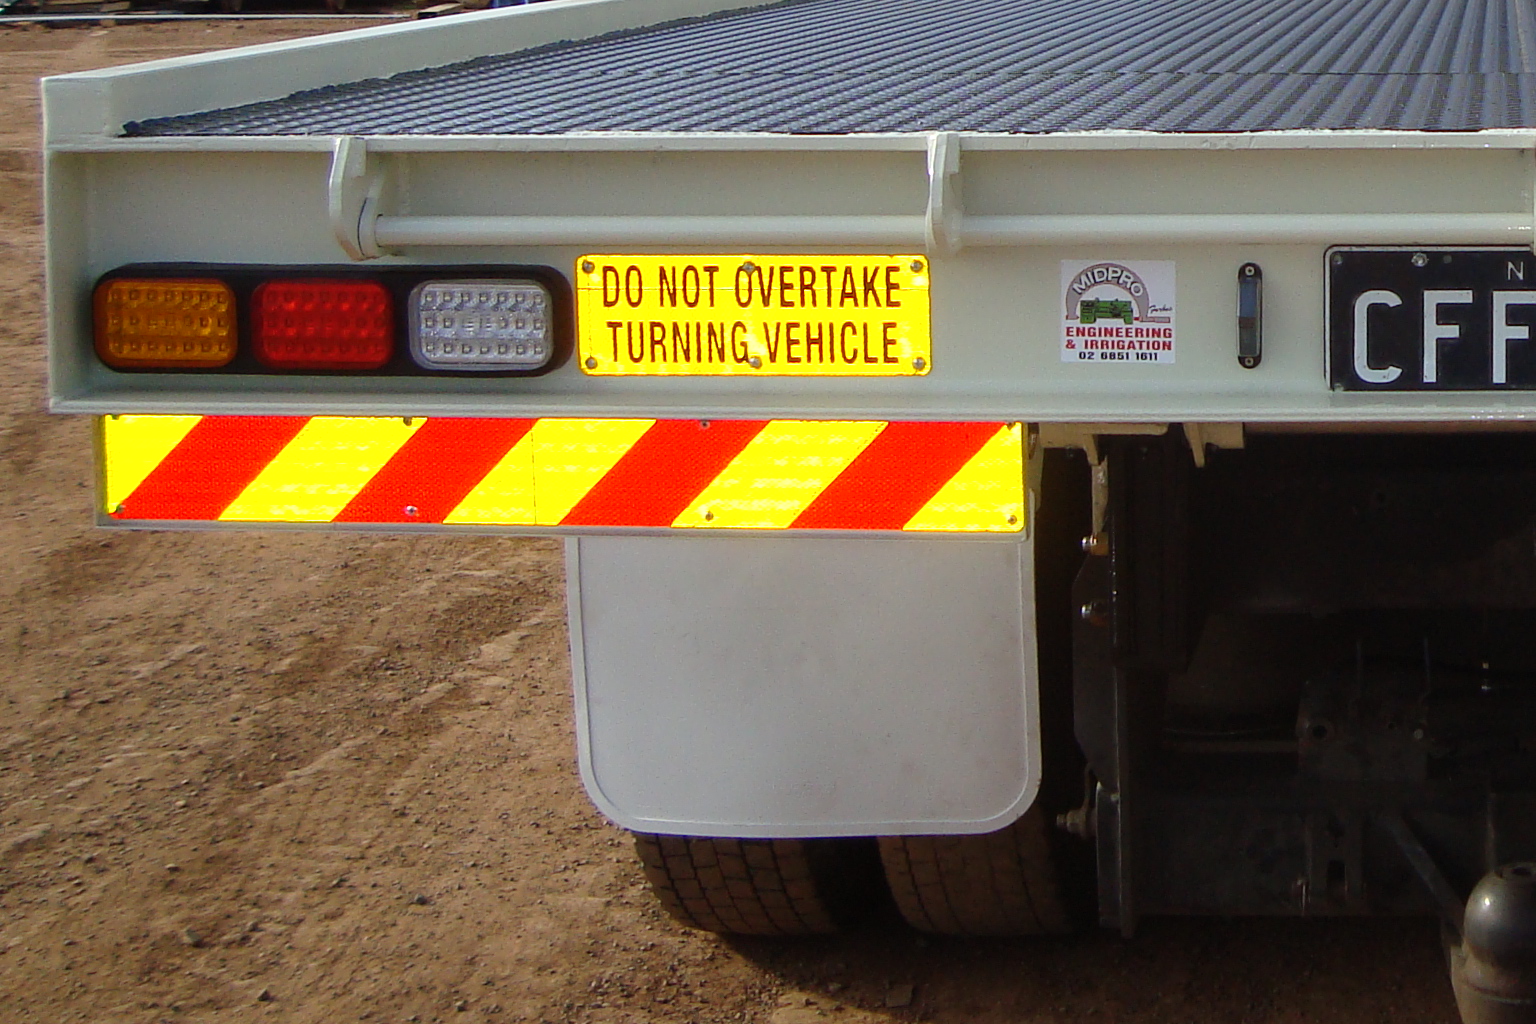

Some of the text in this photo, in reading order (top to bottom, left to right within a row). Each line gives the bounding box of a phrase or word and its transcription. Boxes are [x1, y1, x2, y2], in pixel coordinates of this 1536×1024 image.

[602, 264, 902, 308] DO NOT OVERTAKE
[1072, 266, 1144, 296] MIDPRO
[606, 321, 900, 364] TURNING VEHICLE
[1065, 326, 1173, 339] ENGINEERING
[1065, 338, 1172, 351] & IRRIGATION
[1078, 351, 1158, 361] 02 6851 1611
